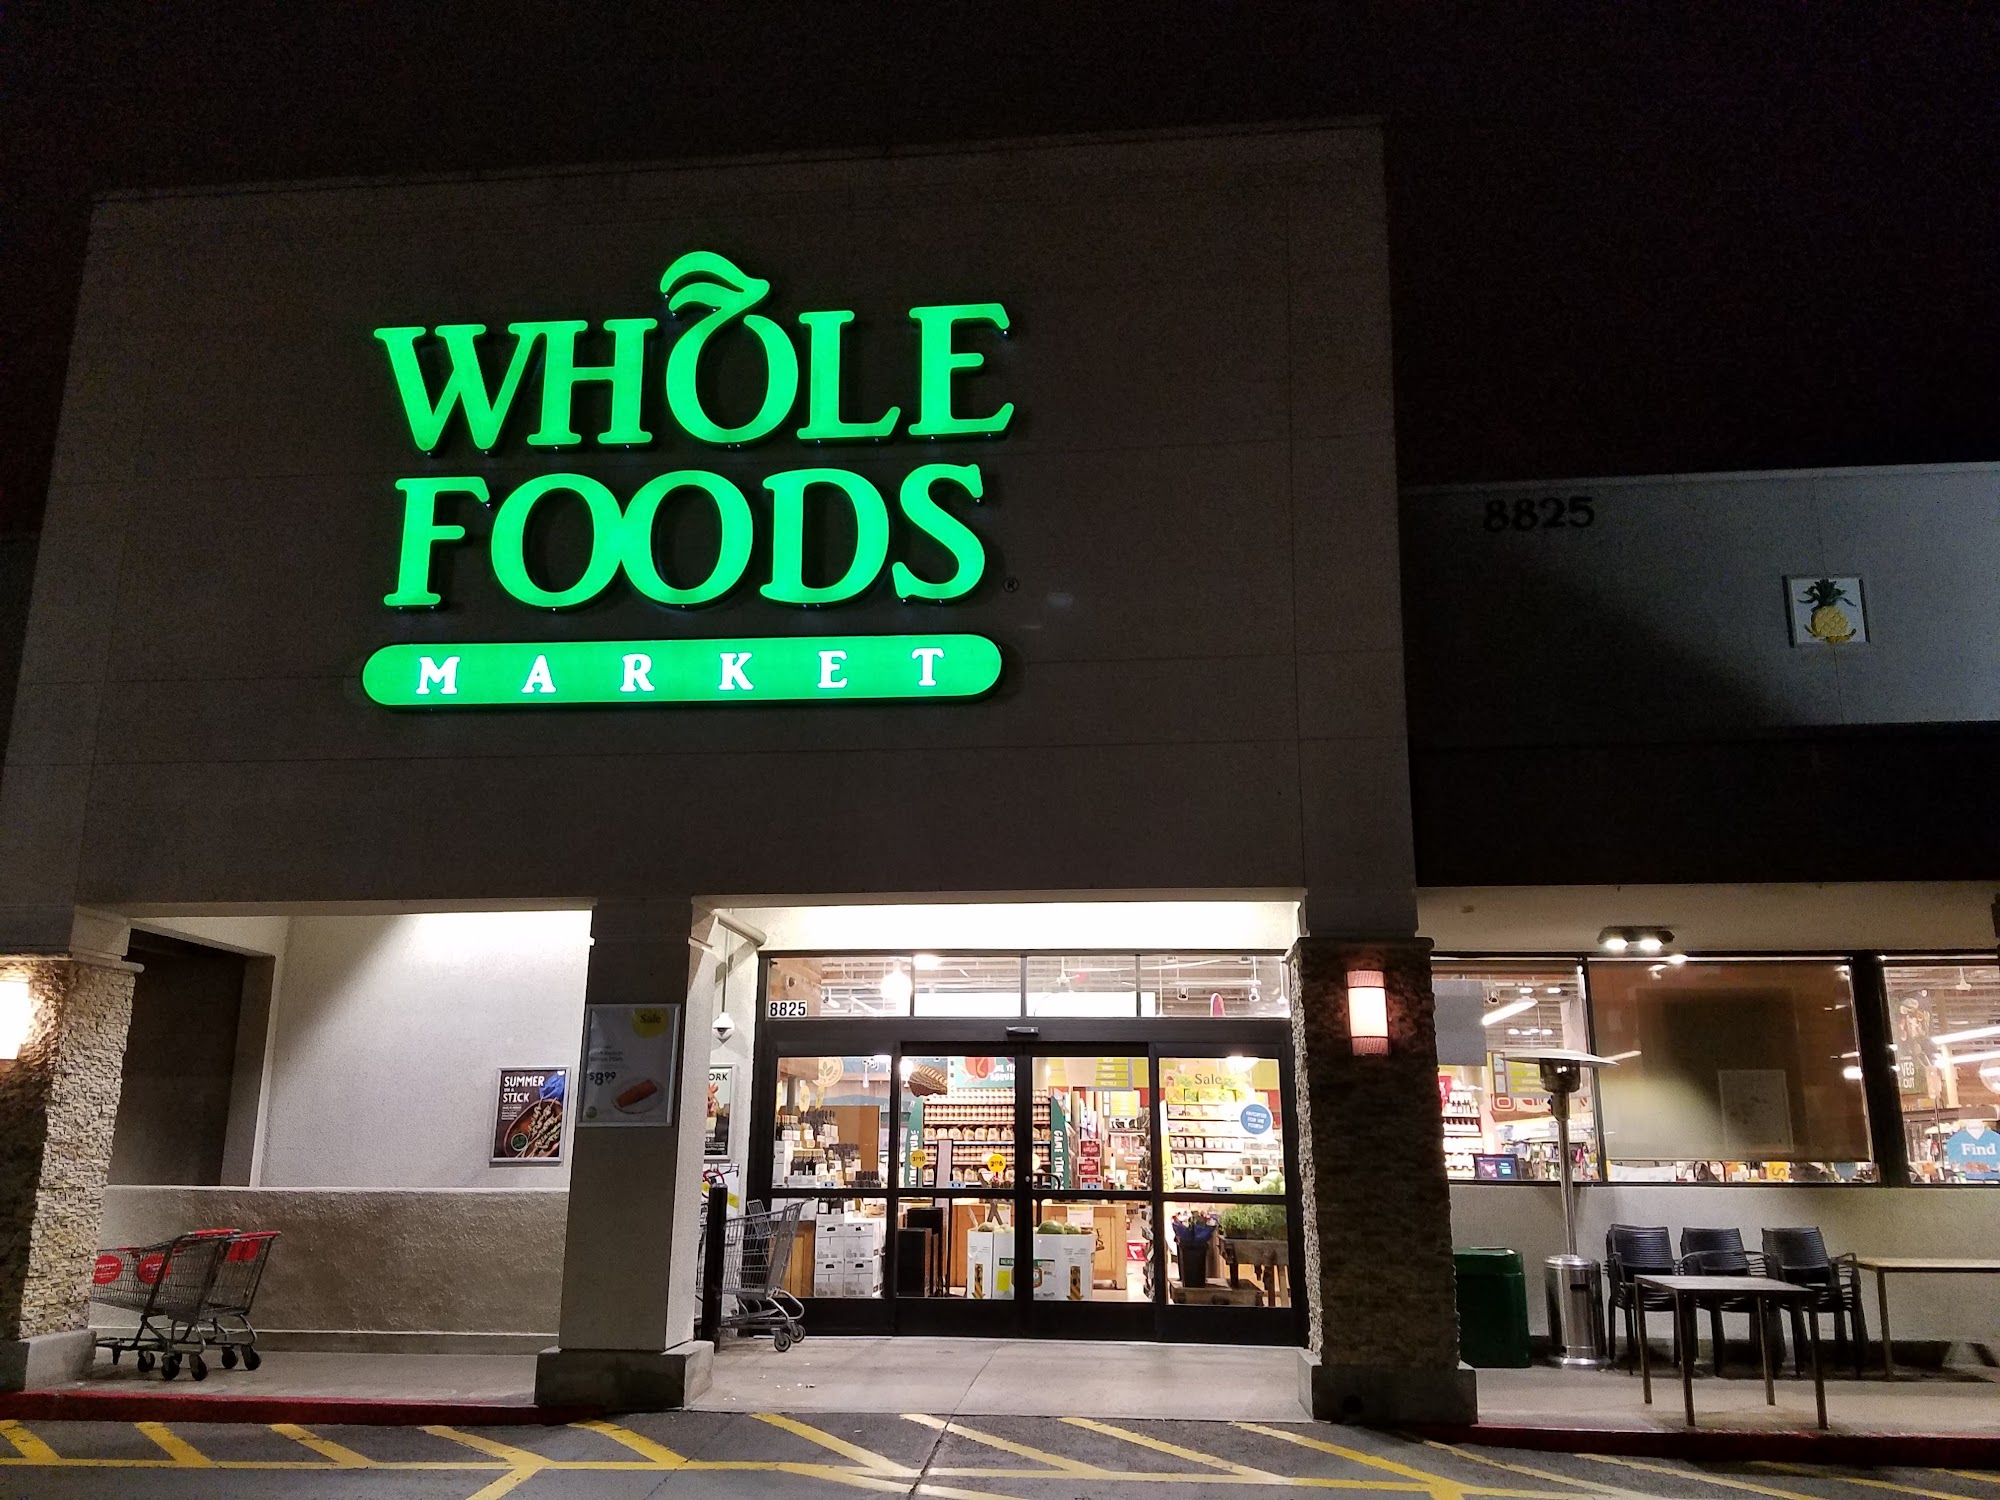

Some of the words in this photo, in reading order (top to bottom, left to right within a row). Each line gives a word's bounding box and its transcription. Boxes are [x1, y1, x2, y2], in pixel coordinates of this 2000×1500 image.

[373, 251, 1015, 452] WHOLE
[1483, 496, 1595, 533] 8825
[383, 463, 986, 608] FOODS
[414, 647, 945, 696] MARKET
[769, 1001, 807, 1017] 8825
[708, 1072, 729, 1082] ORK
[1900, 1061, 1915, 1077] VEG
[503, 1075, 545, 1088] SUMMER
[1194, 1073, 1222, 1085] Sale
[502, 1092, 530, 1103] STICK
[1053, 1130, 1064, 1153] GAME
[1961, 1142, 1997, 1156] Find
